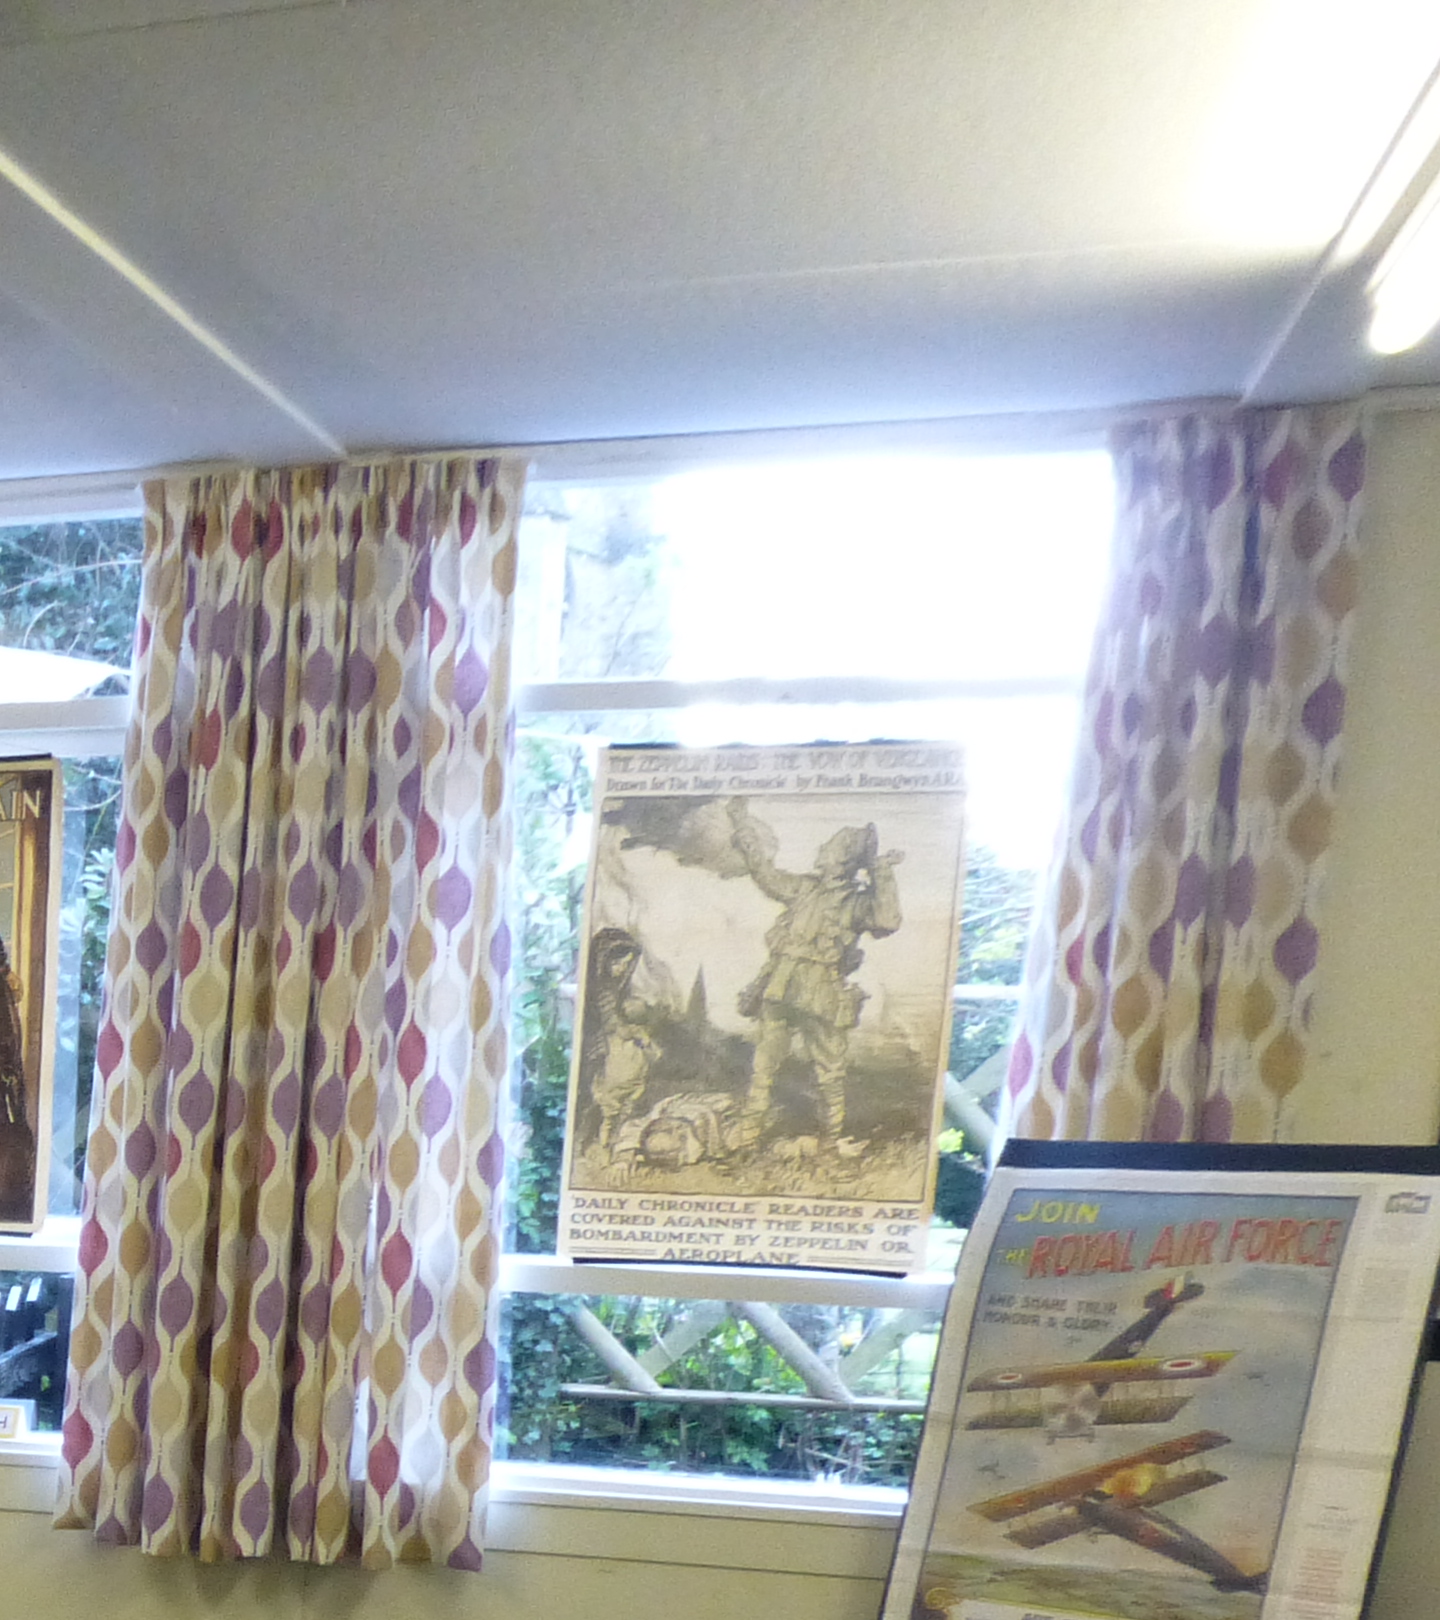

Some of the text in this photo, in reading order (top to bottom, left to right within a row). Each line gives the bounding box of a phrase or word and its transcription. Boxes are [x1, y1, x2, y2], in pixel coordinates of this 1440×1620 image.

[572, 1195, 920, 1220] DAILY CHRONICLE READERS ARE
[1015, 1200, 1101, 1224] JOIN
[571, 1213, 919, 1237] COVERED AGAINST THE RISKS OF
[569, 1228, 913, 1254] BOMBARDMENT BY ZEPPELIN OR
[1026, 1228, 1137, 1279] ROYAL
[1145, 1220, 1219, 1271] AIR
[1223, 1217, 1342, 1267] FORCE
[662, 1247, 800, 1265] AEROPLANE
